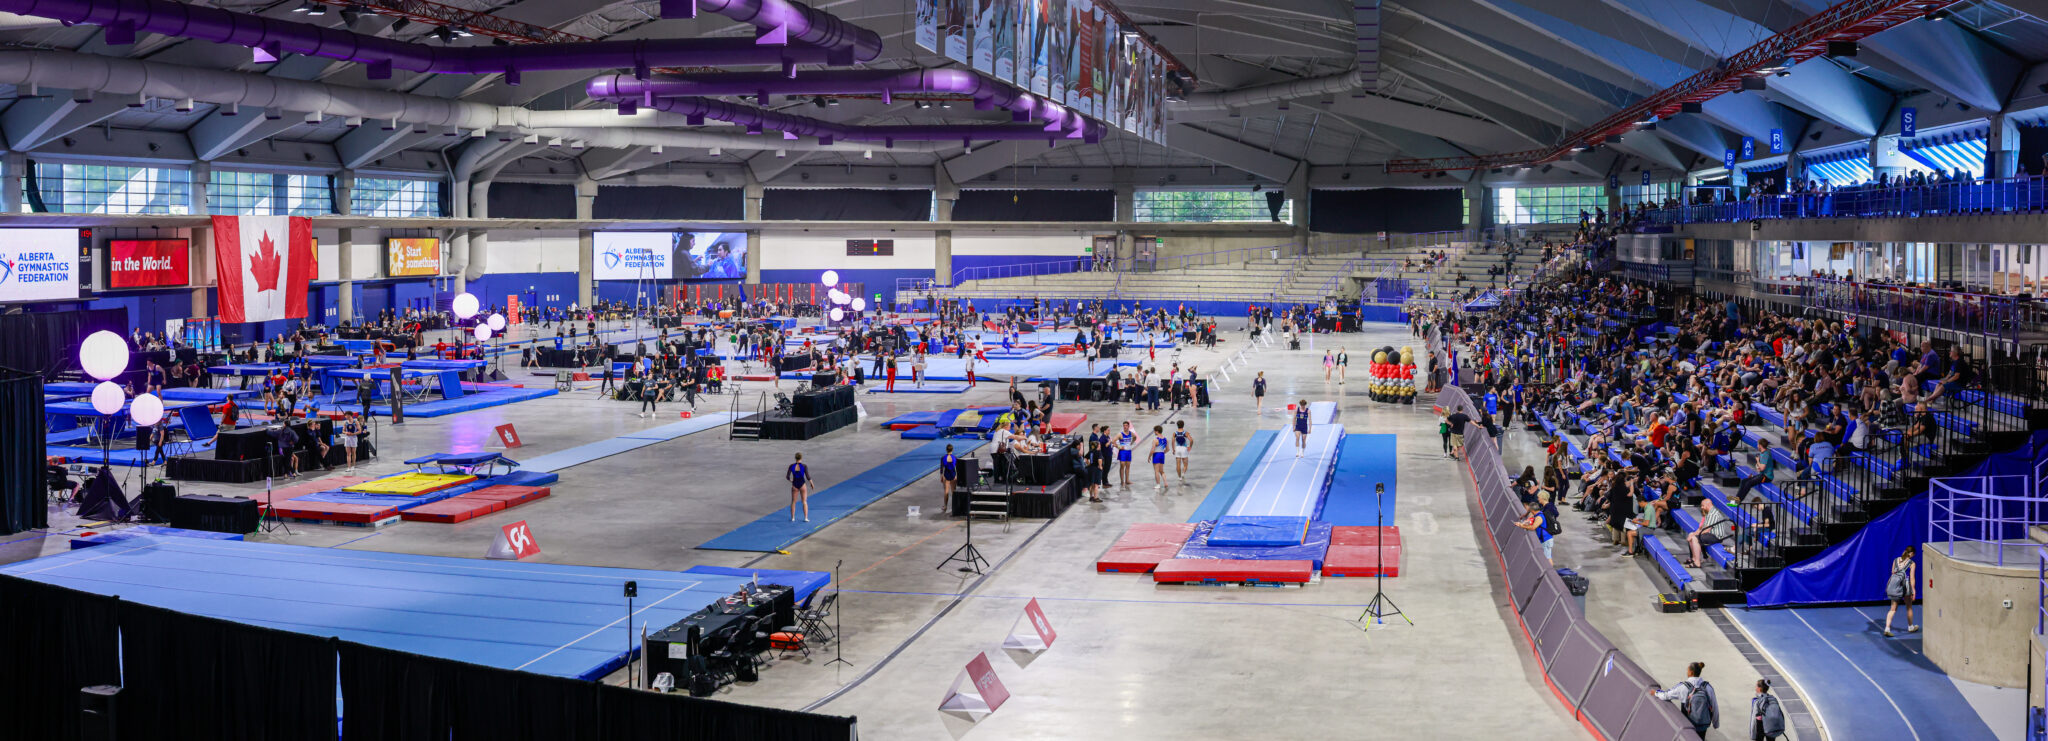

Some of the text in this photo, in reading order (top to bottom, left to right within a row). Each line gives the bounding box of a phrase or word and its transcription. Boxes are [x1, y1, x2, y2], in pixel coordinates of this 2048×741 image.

[1904, 112, 1913, 123] S
[1773, 133, 1780, 142] R
[1745, 140, 1752, 149] A
[1727, 152, 1733, 160] B
[406, 245, 422, 257] Start
[18, 252, 54, 261] ALBERTA
[18, 262, 69, 272] GYMNASTICS
[111, 255, 173, 271] in the World.
[406, 256, 439, 271] something
[18, 273, 69, 283] FEDERATION
